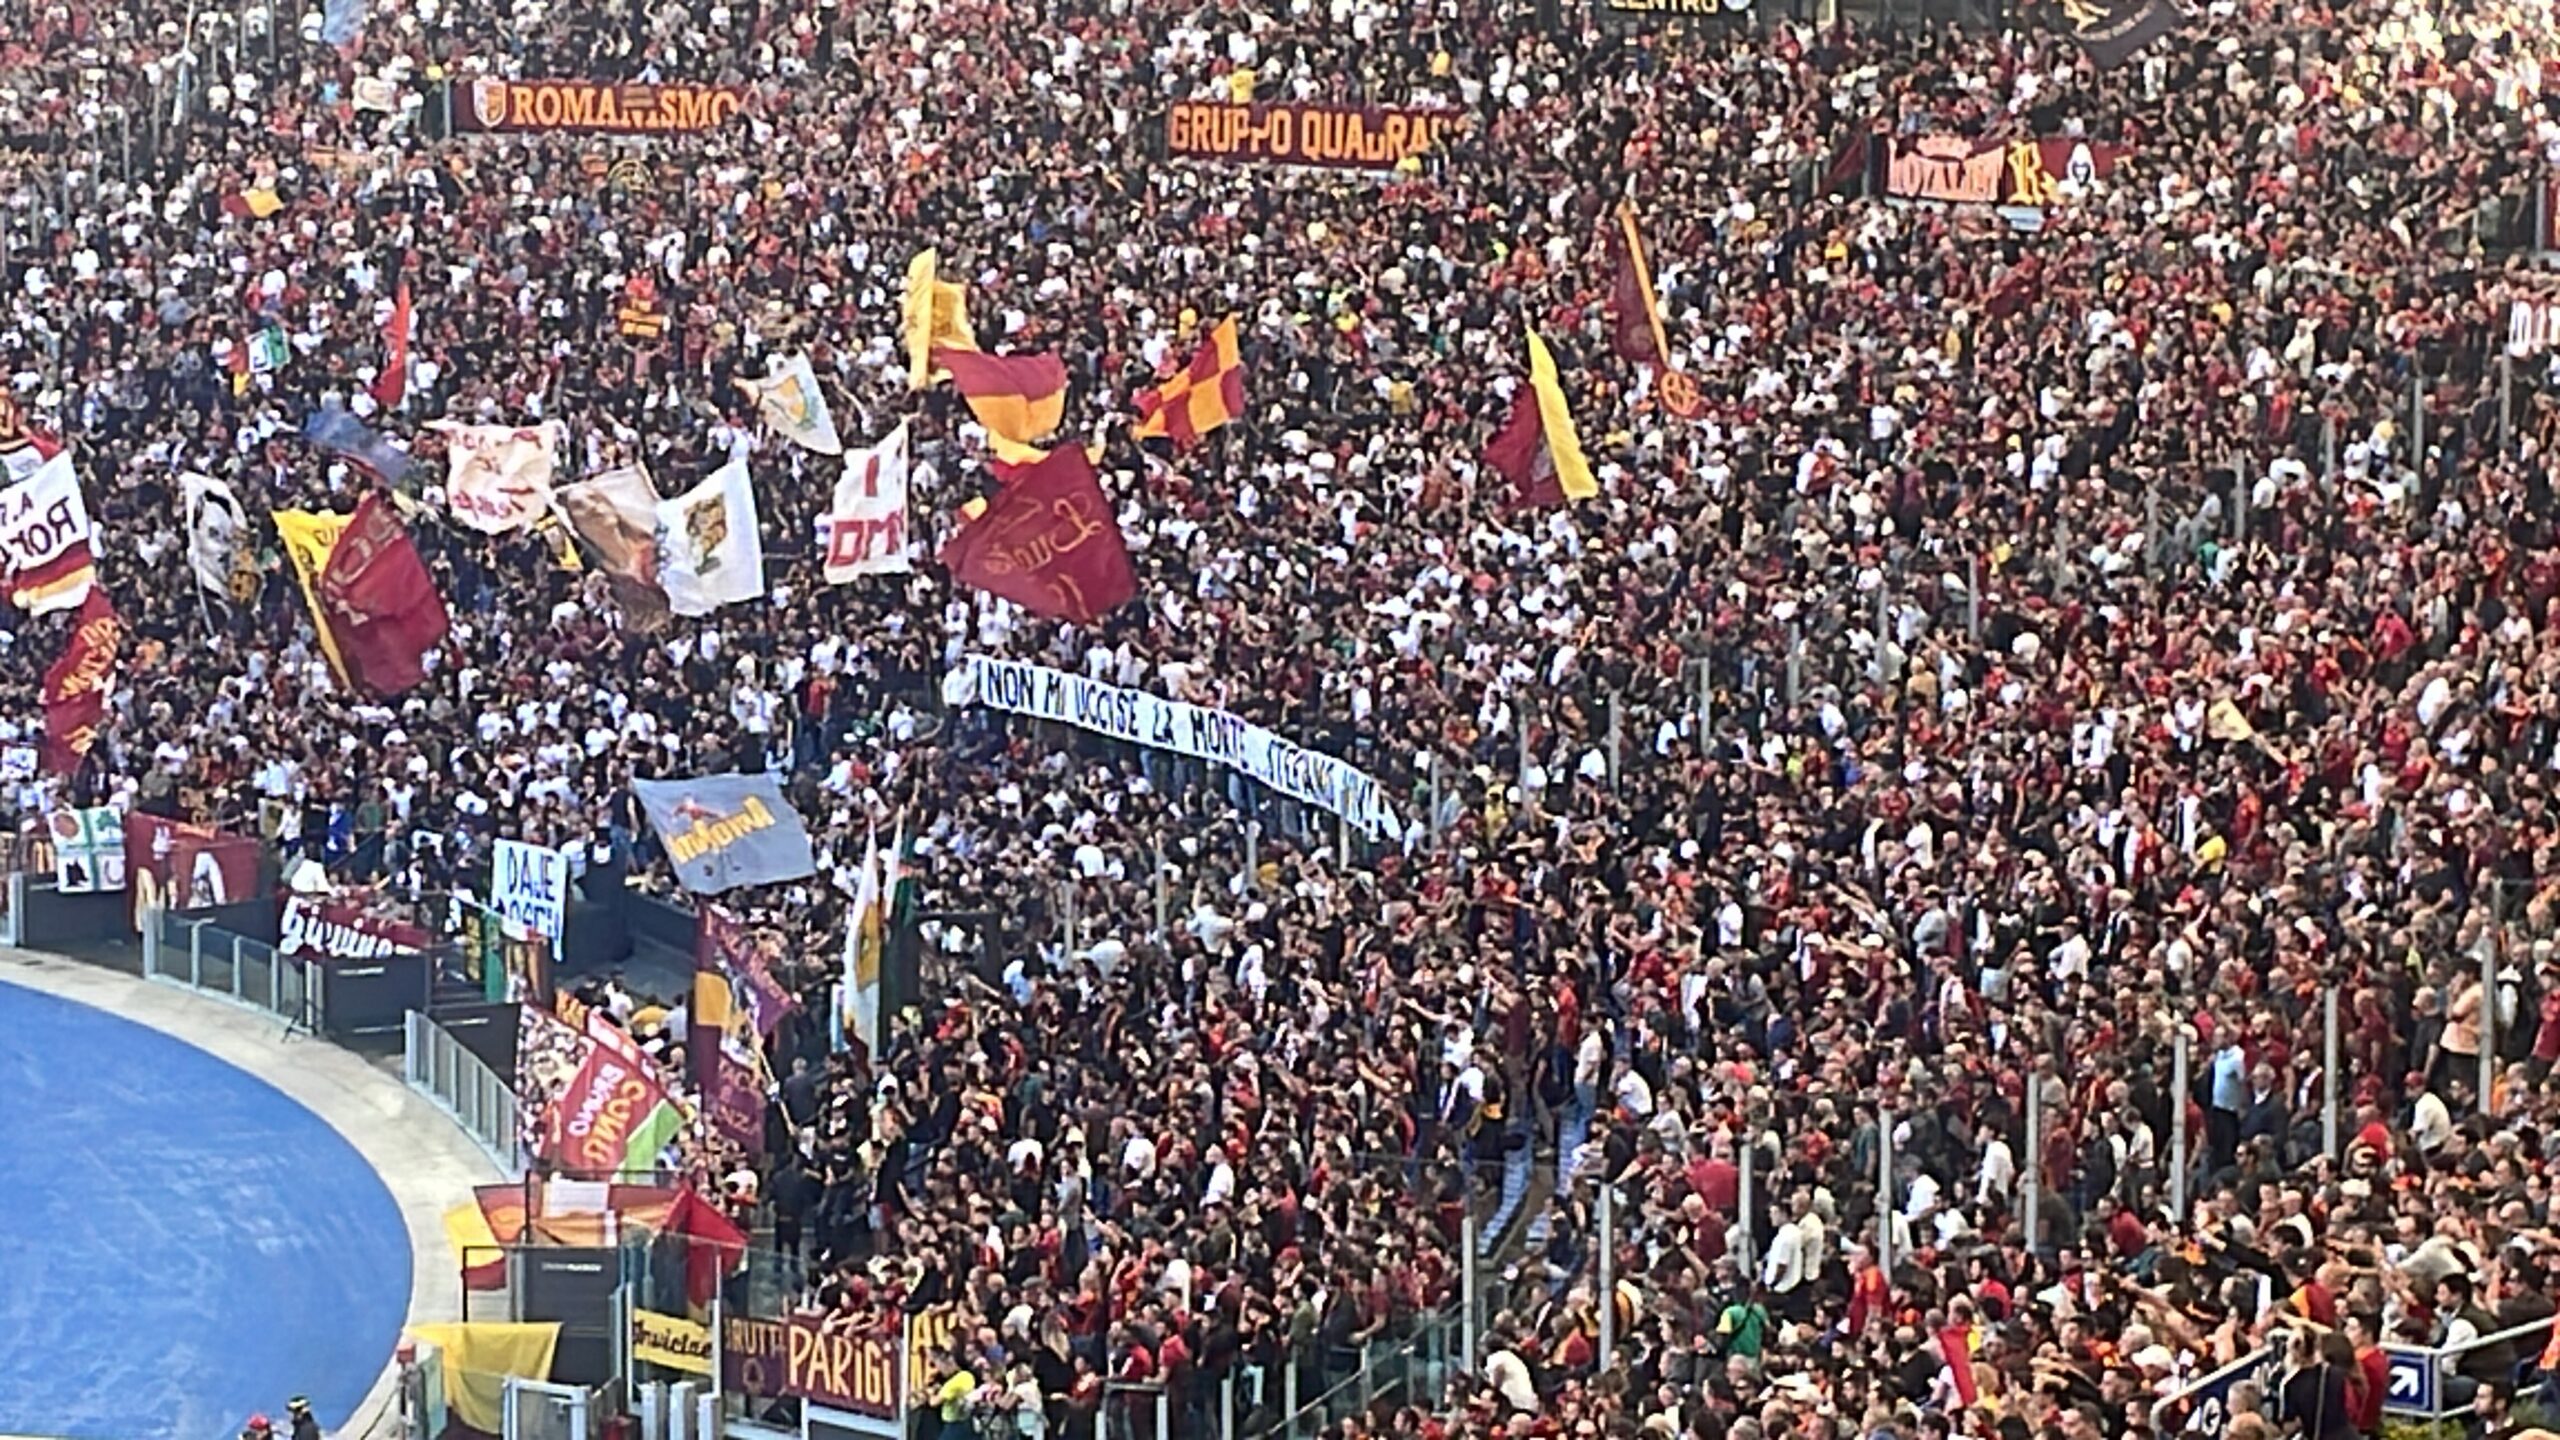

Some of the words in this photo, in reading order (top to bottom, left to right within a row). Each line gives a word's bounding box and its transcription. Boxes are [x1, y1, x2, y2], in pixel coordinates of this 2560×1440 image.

[1301, 109, 1450, 162] QUADRA
[987, 660, 1034, 712] NON
[1043, 671, 1066, 717] MI
[1073, 679, 1139, 737] UCCISE
[1152, 701, 1176, 747] LA
[1190, 708, 1249, 771] MORTE
